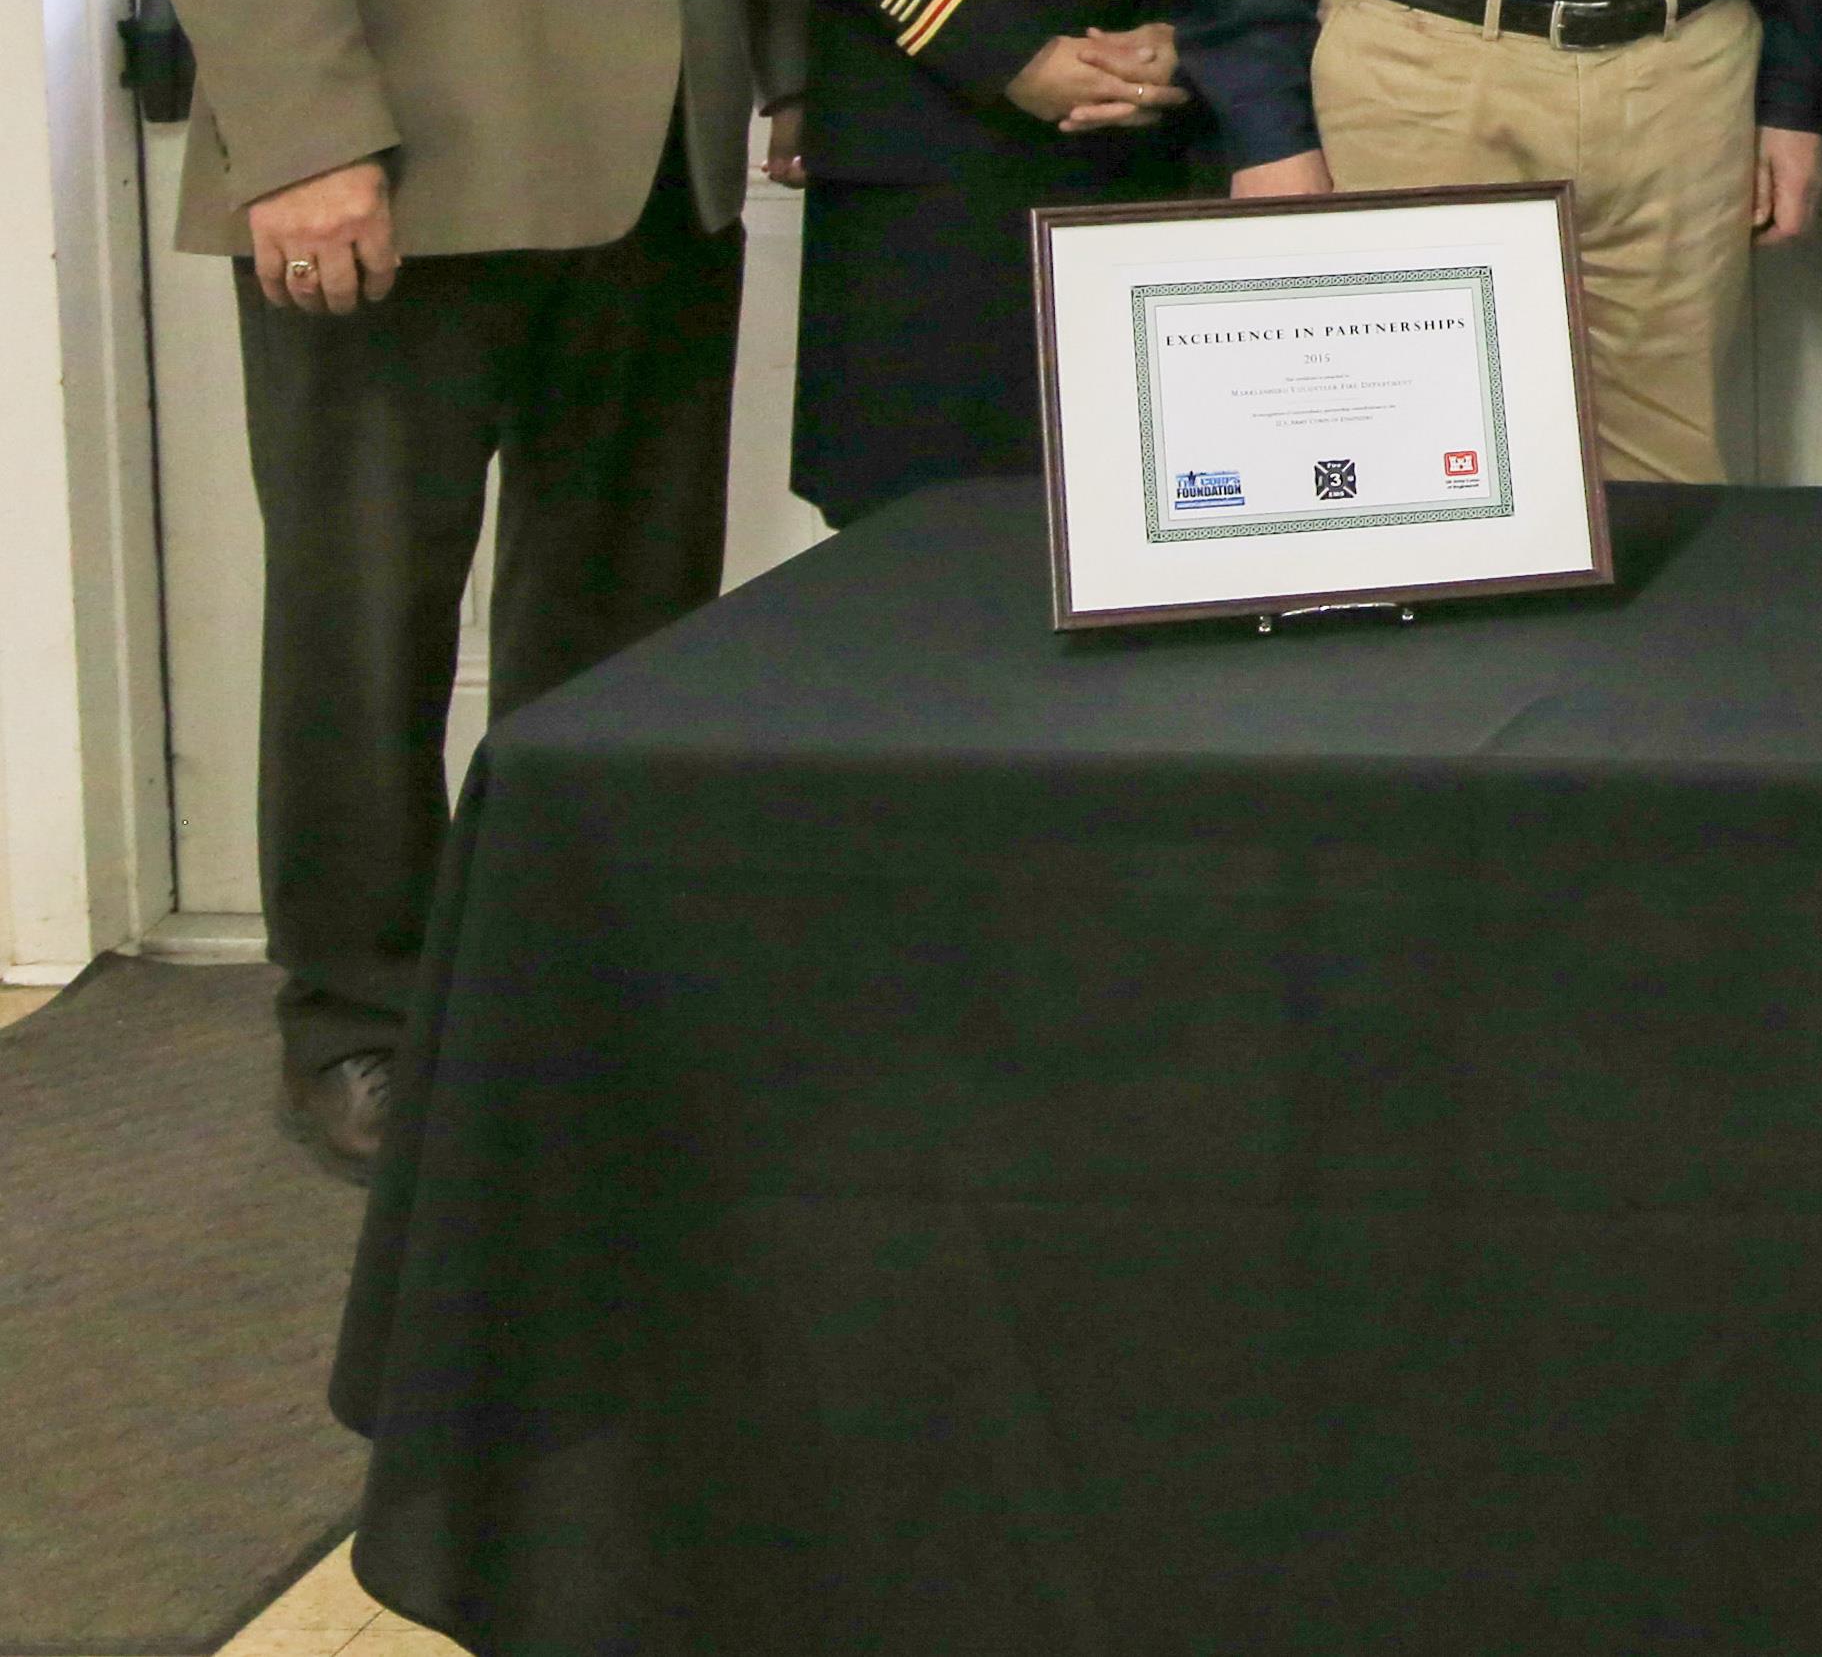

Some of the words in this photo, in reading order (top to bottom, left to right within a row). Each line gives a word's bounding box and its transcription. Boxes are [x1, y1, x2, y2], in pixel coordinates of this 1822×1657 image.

[1165, 328, 1285, 346] EXCELLENCE
[1295, 327, 1315, 339] IN
[1325, 318, 1466, 338] PARTNERSHIPS
[1304, 353, 1331, 364] 2015
[1329, 472, 1342, 487] 3
[1176, 484, 1242, 499] FOUNDATION
